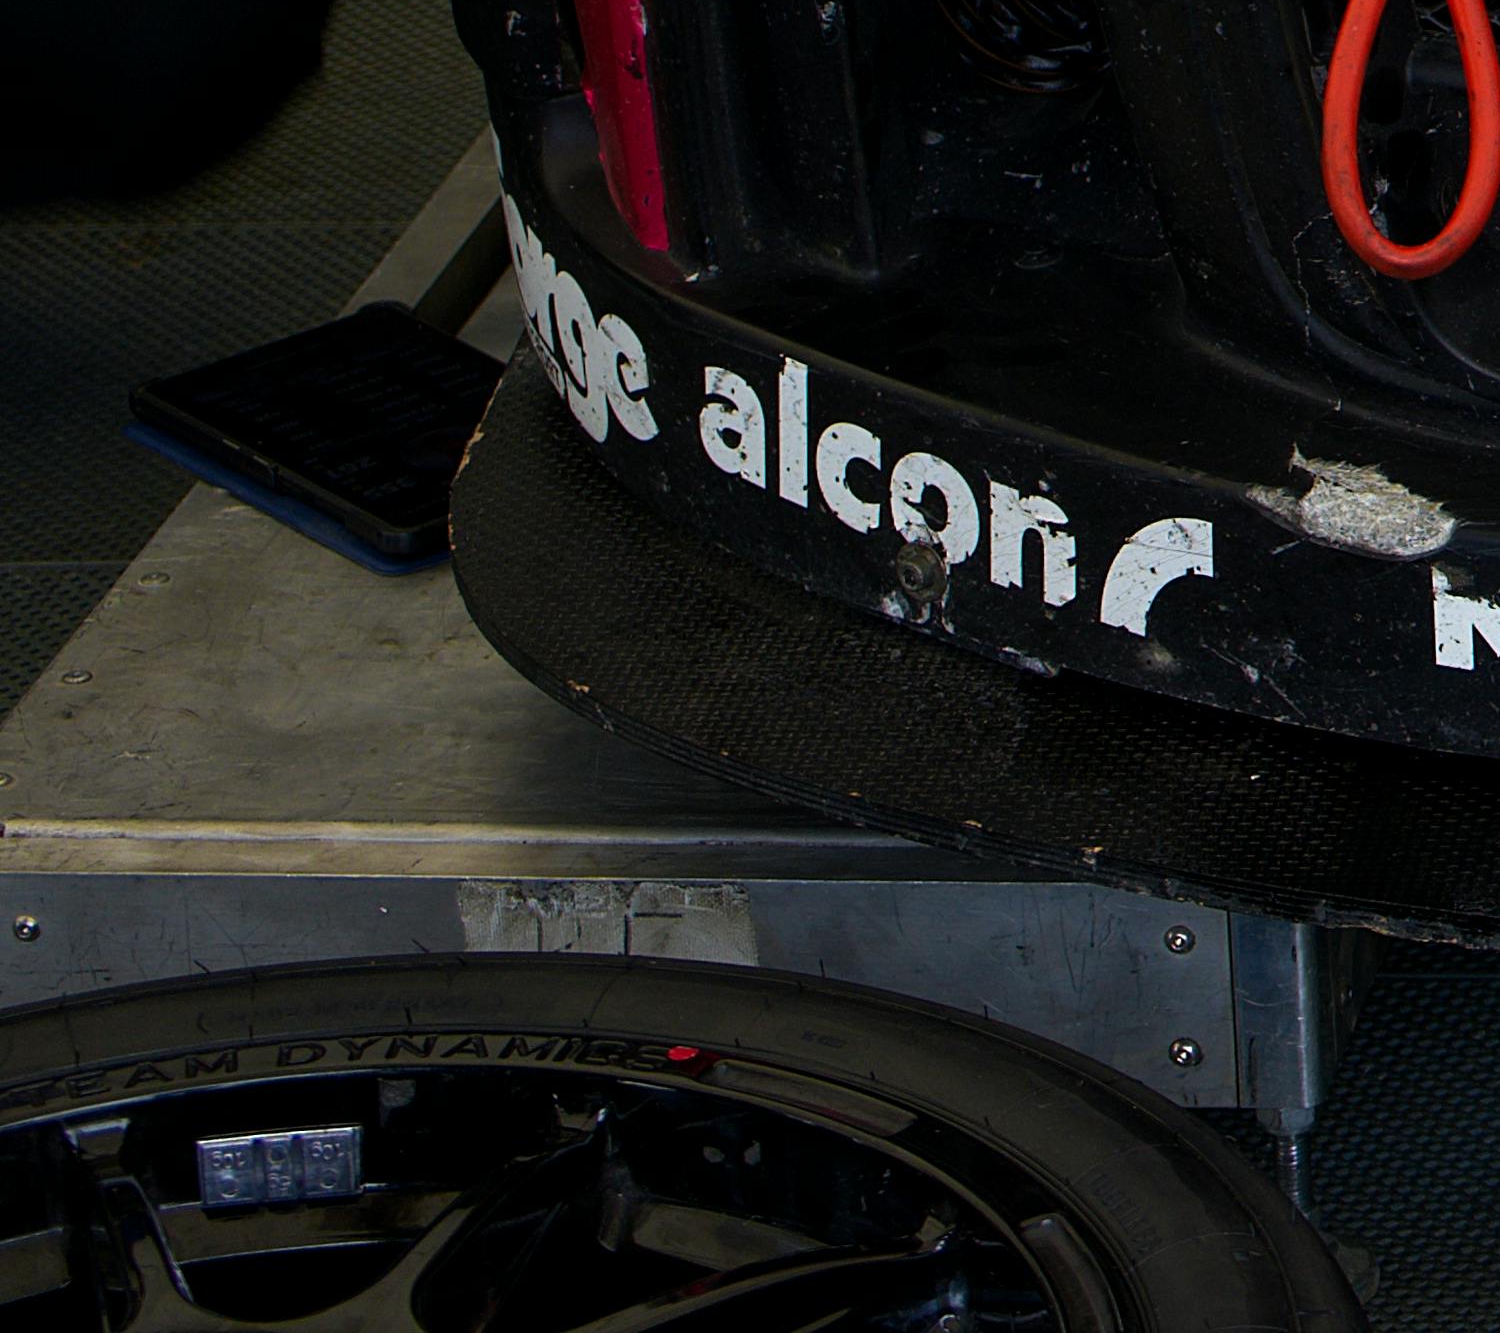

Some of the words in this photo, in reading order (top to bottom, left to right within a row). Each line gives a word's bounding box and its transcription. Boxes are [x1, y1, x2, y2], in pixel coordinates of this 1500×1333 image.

[489, 123, 661, 443] orge
[700, 355, 1077, 607] alcon
[9, 1048, 239, 1109] TEAM
[275, 1033, 672, 1071] DYNAMICS
